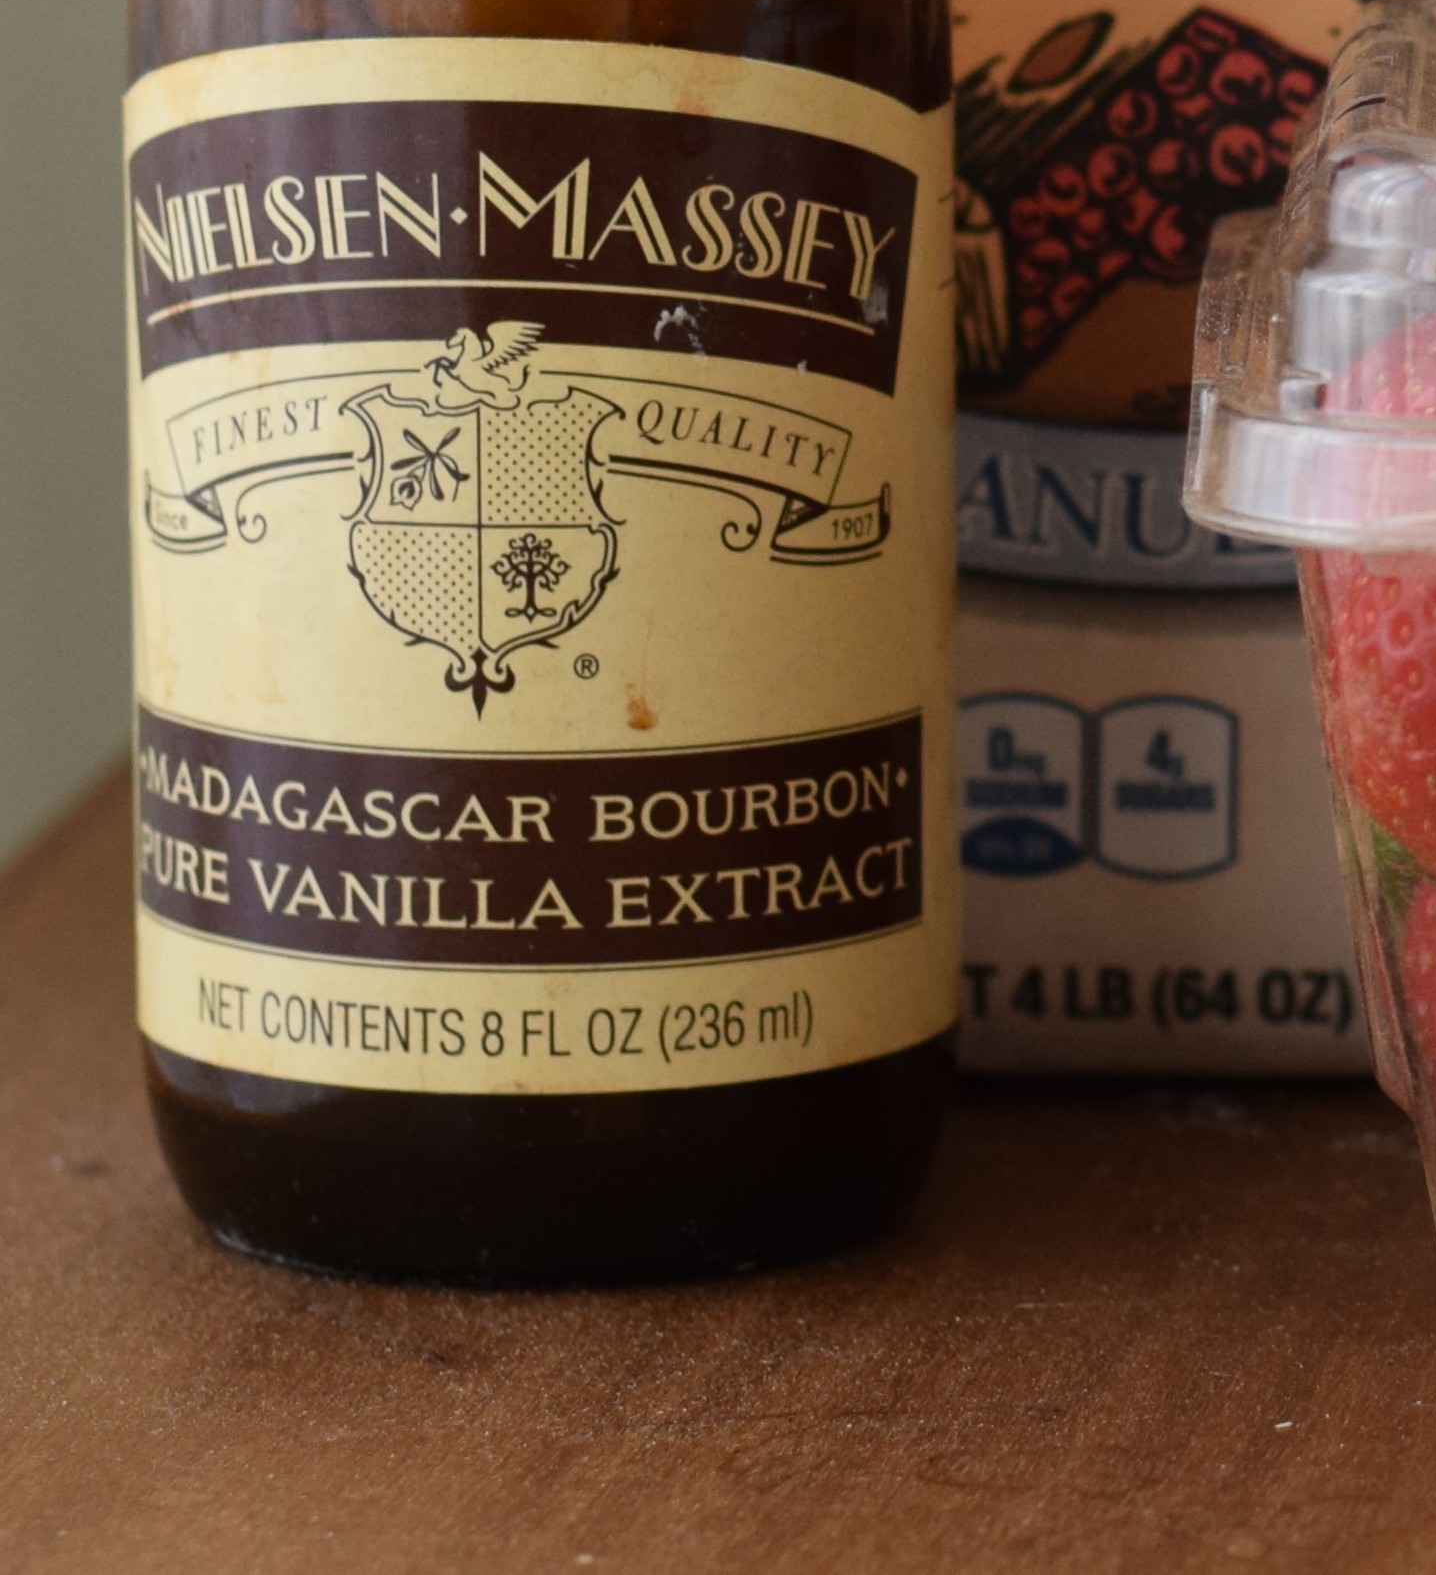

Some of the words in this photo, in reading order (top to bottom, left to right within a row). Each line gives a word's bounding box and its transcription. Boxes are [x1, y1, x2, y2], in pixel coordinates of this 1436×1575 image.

[191, 395, 329, 464] FINEST
[636, 398, 836, 476] QUALITY
[831, 512, 874, 541] 1907
[145, 751, 552, 843] MADAGASCAR
[589, 760, 892, 842] BOURBON
[140, 831, 231, 905] PURE
[247, 859, 584, 930] VANILLA
[605, 838, 915, 929] EXTRACT
[198, 977, 251, 1030] NET
[261, 990, 467, 1058] CONTENTS
[479, 1010, 505, 1057] 8
[520, 1009, 571, 1058] FL
[586, 1008, 643, 1057] OZ
[658, 1004, 745, 1064] (236
[757, 989, 815, 1048] ml)
[962, 962, 997, 1022] T
[1011, 965, 1046, 1022] 4
[1063, 962, 1133, 1022] LB
[1150, 964, 1239, 1032] (64
[1256, 965, 1354, 1038] OZ)
